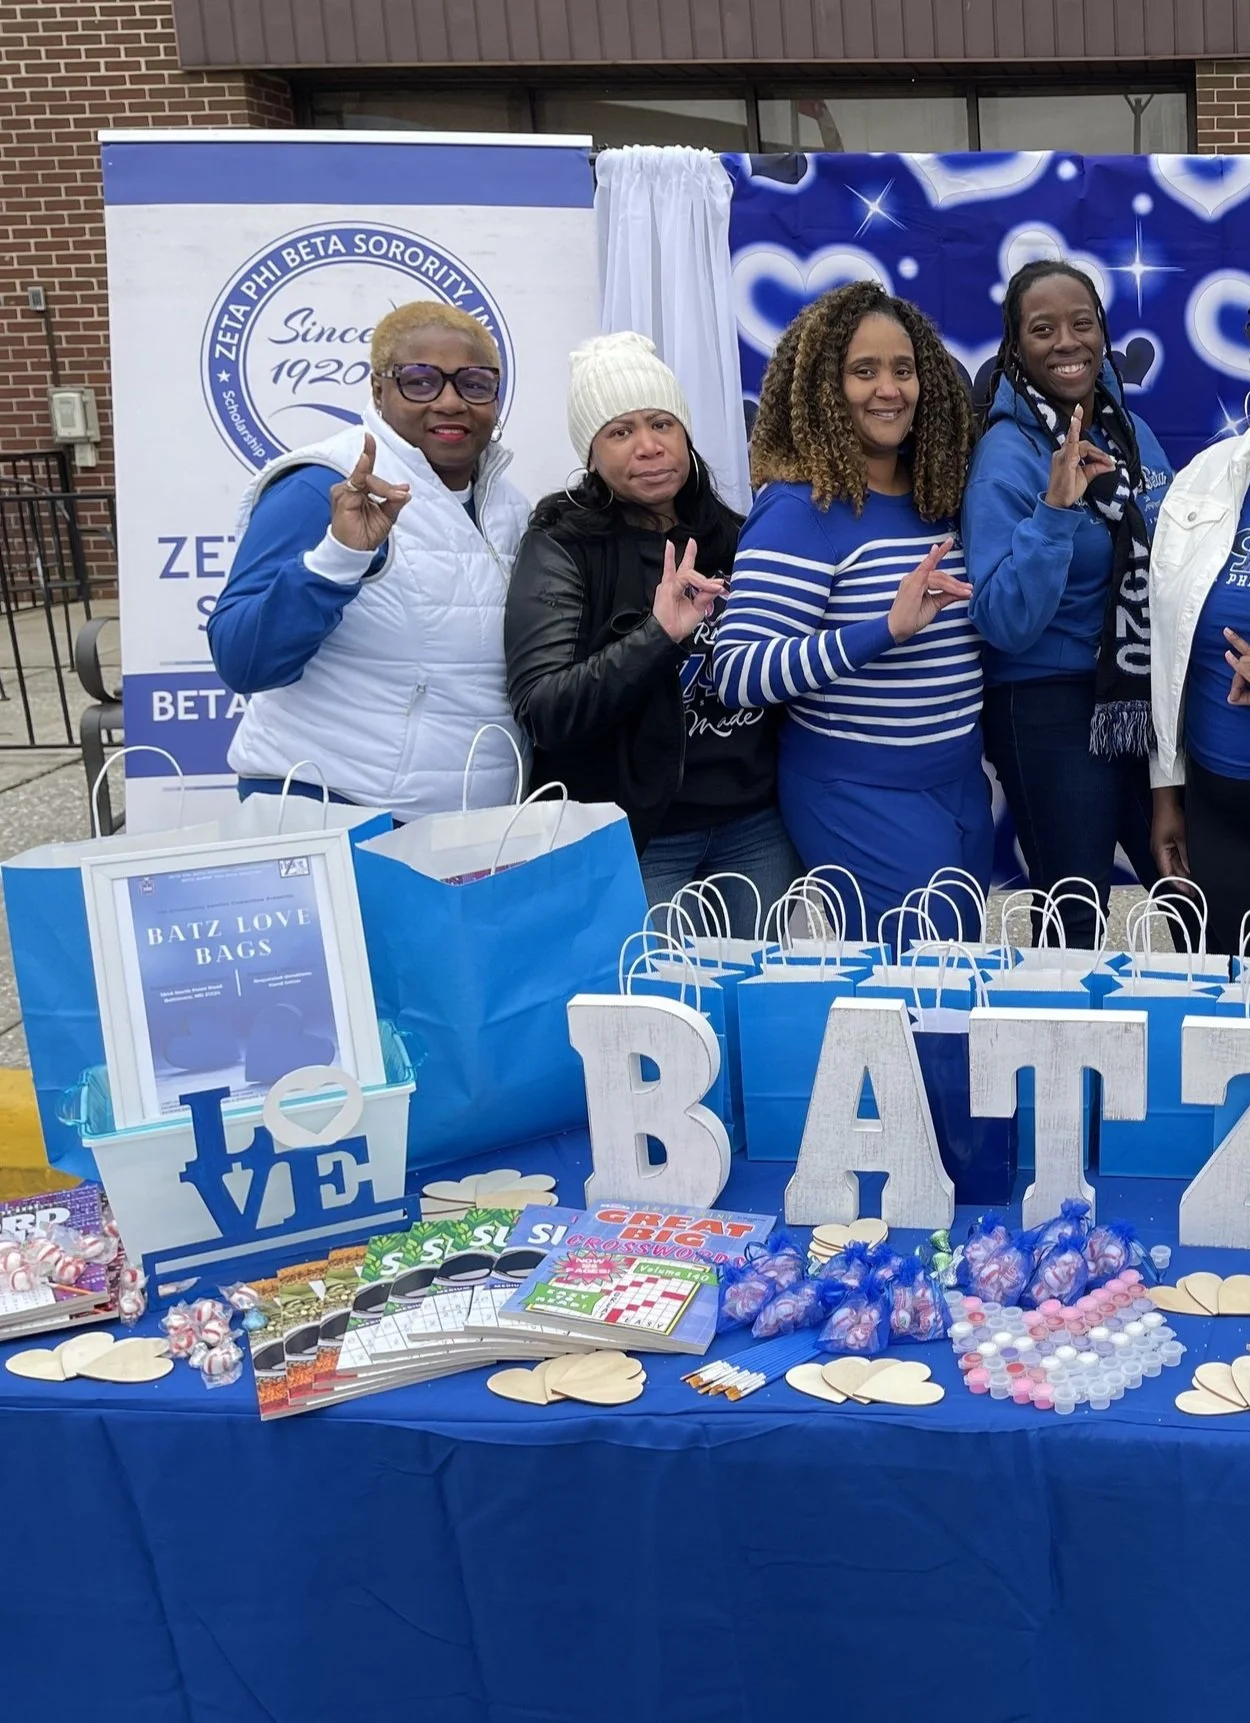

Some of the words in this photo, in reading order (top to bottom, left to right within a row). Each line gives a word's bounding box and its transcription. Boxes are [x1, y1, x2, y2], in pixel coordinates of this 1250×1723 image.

[215, 302, 251, 361] ZETA
[240, 259, 282, 300] PHI
[282, 234, 346, 268] BETA
[353, 233, 473, 307] SORORITY,
[268, 307, 373, 344] Since
[271, 358, 371, 395] 1920
[222, 390, 266, 458] Scholarship
[152, 689, 250, 722] BETA
[684, 704, 764, 738] Made
[147, 919, 222, 945] BATZ
[236, 908, 312, 935] LOVE
[195, 939, 272, 966] BAGS
[595, 1208, 755, 1238] GREAT
[618, 1226, 708, 1248] BIG
[640, 1264, 681, 1276] Volume
[687, 1271, 710, 1282] 140
